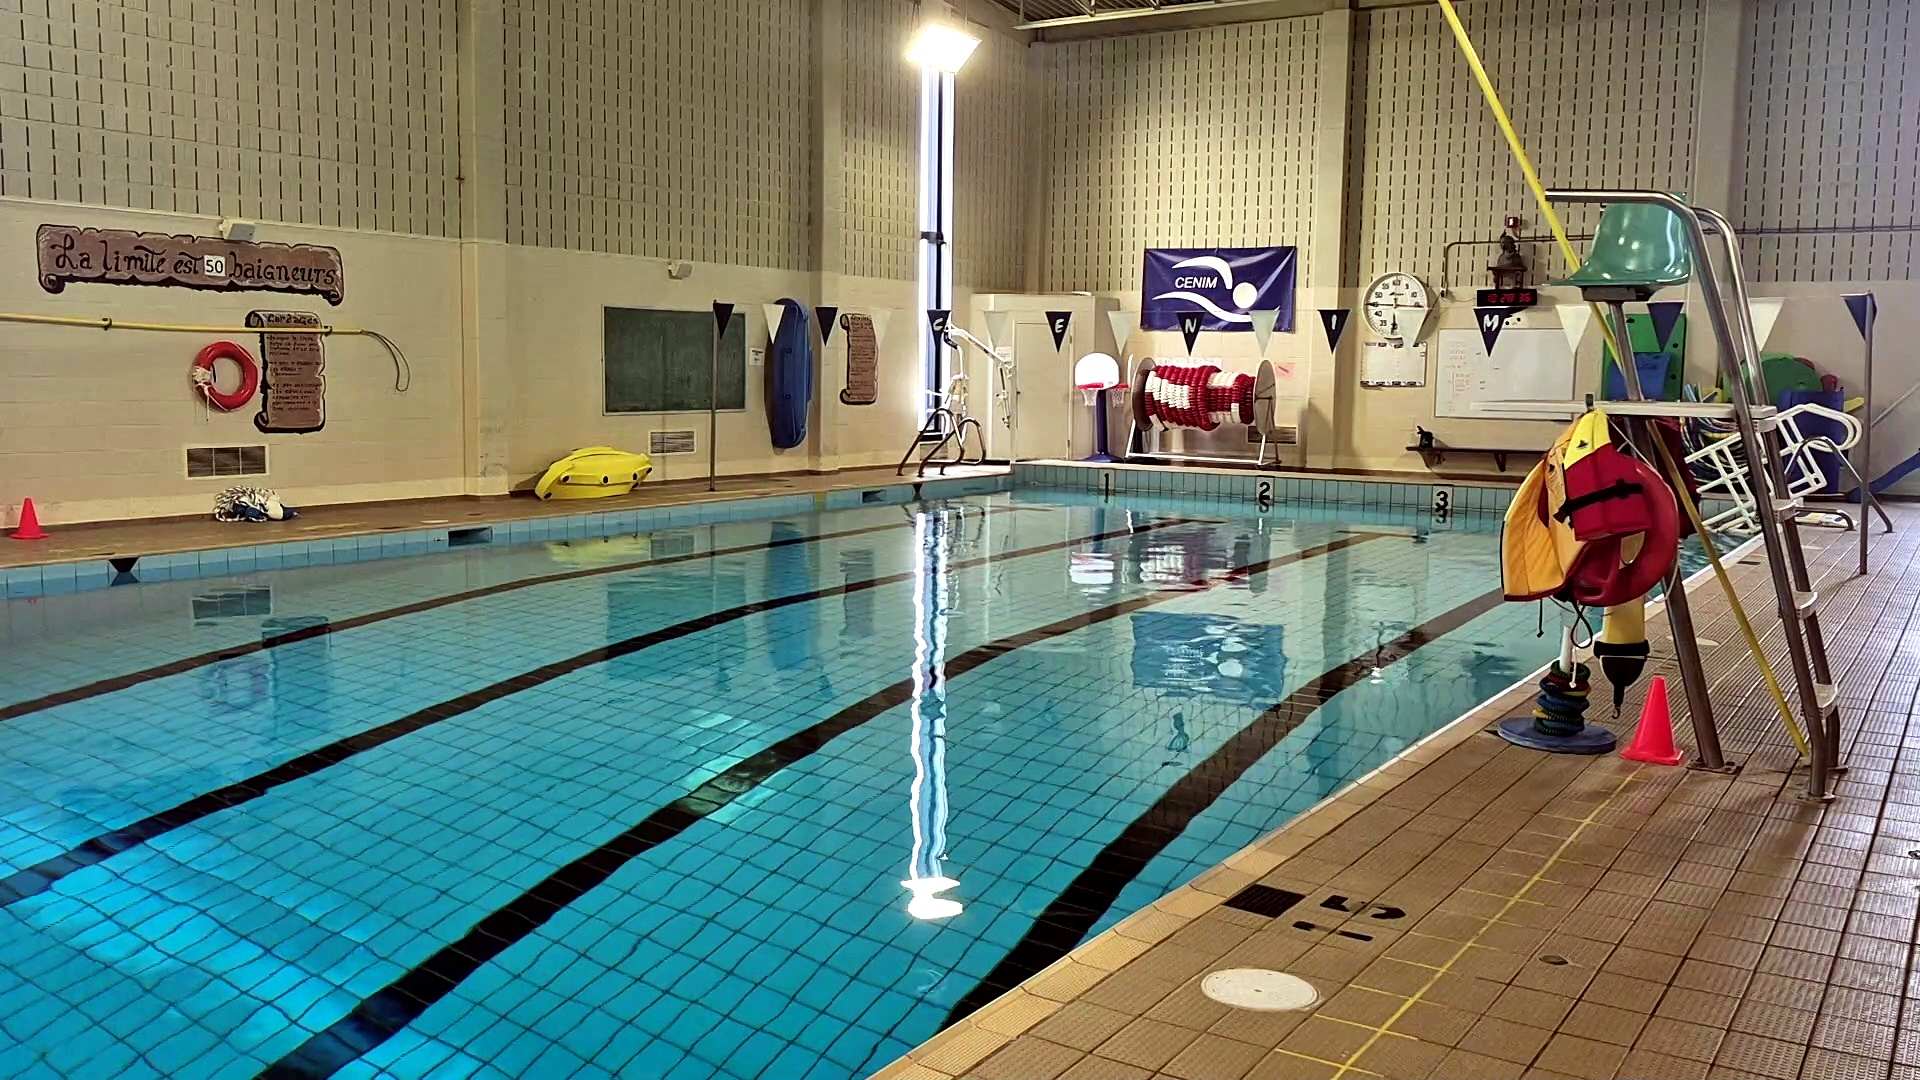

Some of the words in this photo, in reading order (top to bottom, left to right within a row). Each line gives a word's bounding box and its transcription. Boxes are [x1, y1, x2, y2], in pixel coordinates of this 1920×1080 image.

[50, 234, 92, 269] La
[100, 240, 167, 274] limite
[173, 252, 204, 274] est
[205, 259, 224, 274] 50
[228, 251, 336, 285] baigneurs
[1175, 277, 1218, 289] CENIM
[932, 318, 944, 331] C
[1055, 318, 1065, 334] E
[1185, 318, 1197, 334] N
[1483, 314, 1500, 333] M
[1258, 481, 1271, 500] 2
[1435, 490, 1449, 509] 3
